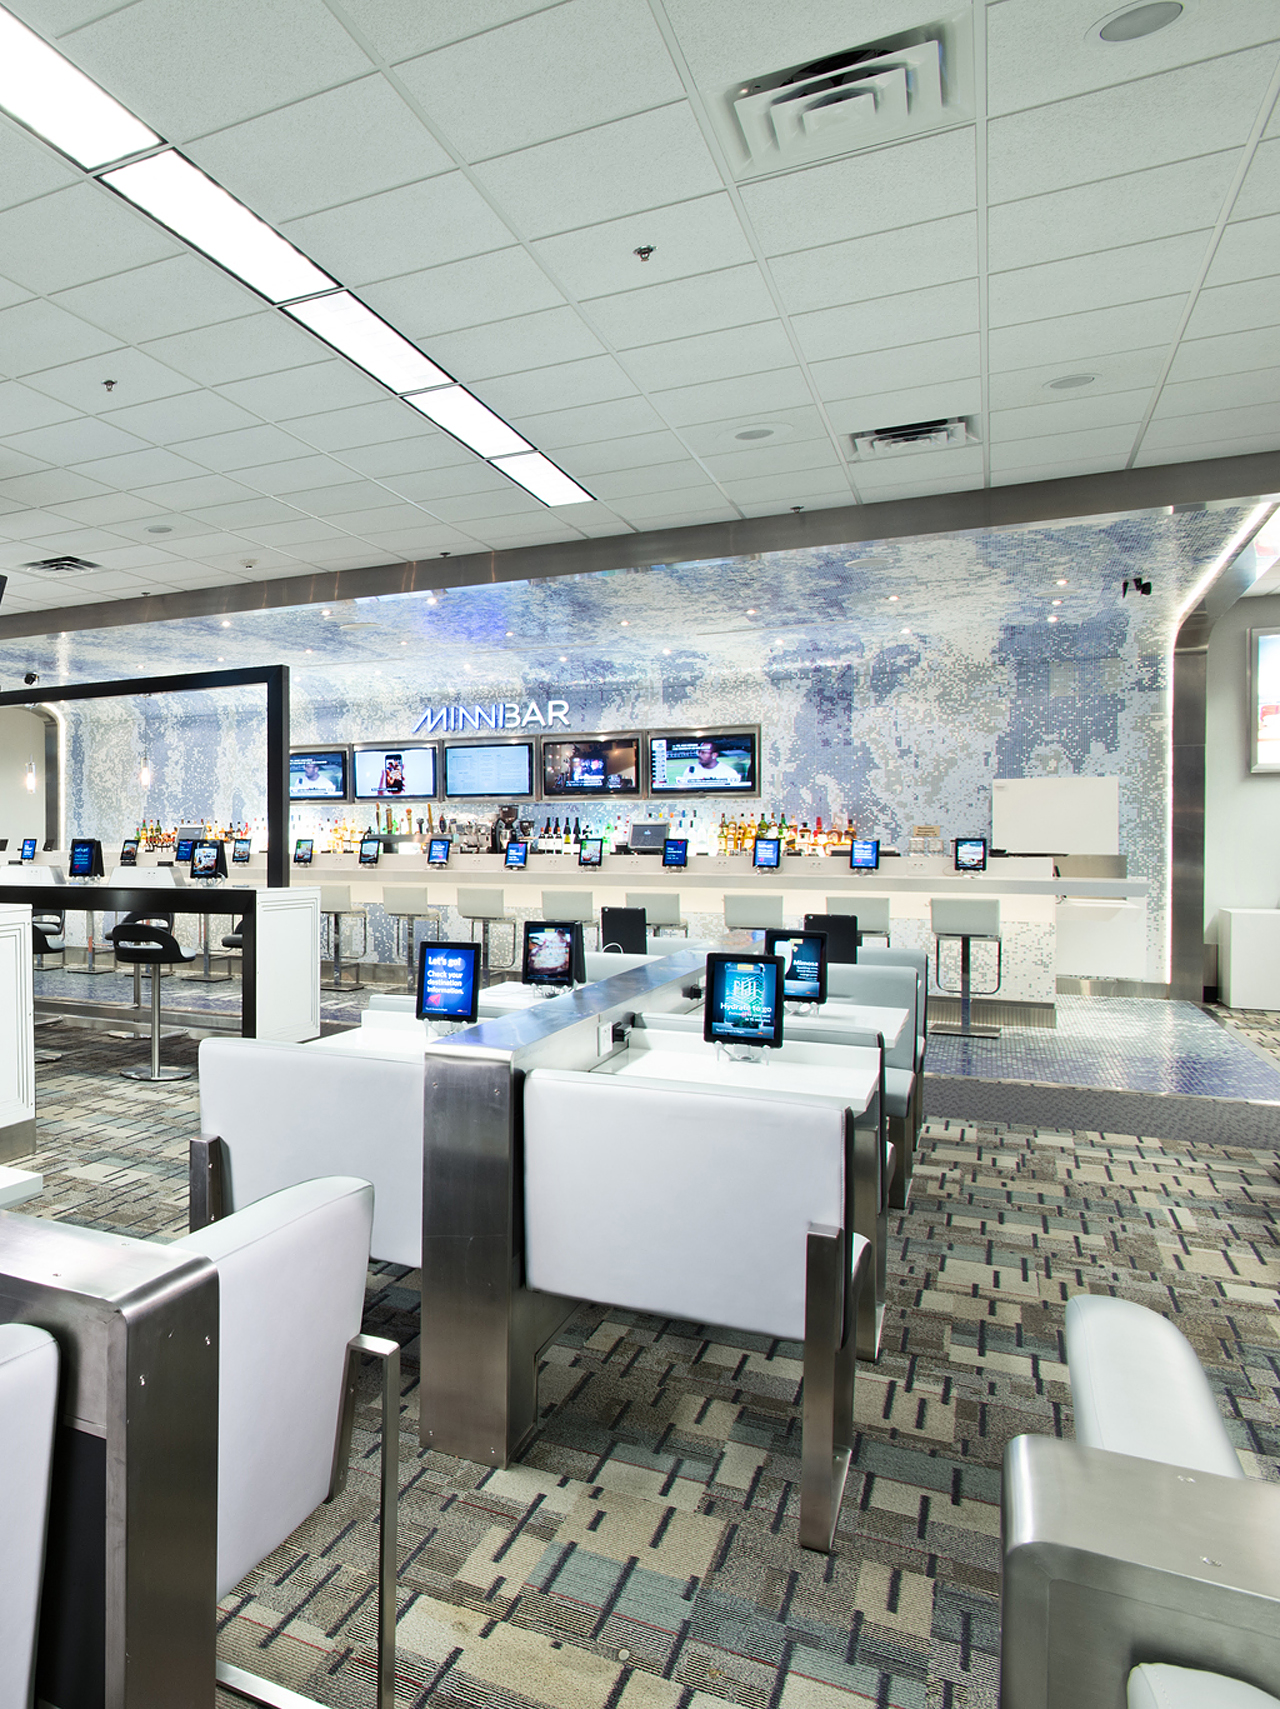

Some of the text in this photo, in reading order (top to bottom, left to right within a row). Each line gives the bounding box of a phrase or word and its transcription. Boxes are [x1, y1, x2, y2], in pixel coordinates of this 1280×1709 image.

[411, 700, 571, 733] MINNIBAR
[428, 956, 447, 966] Let's
[427, 970, 447, 978] Check
[427, 978, 462, 987] destination
